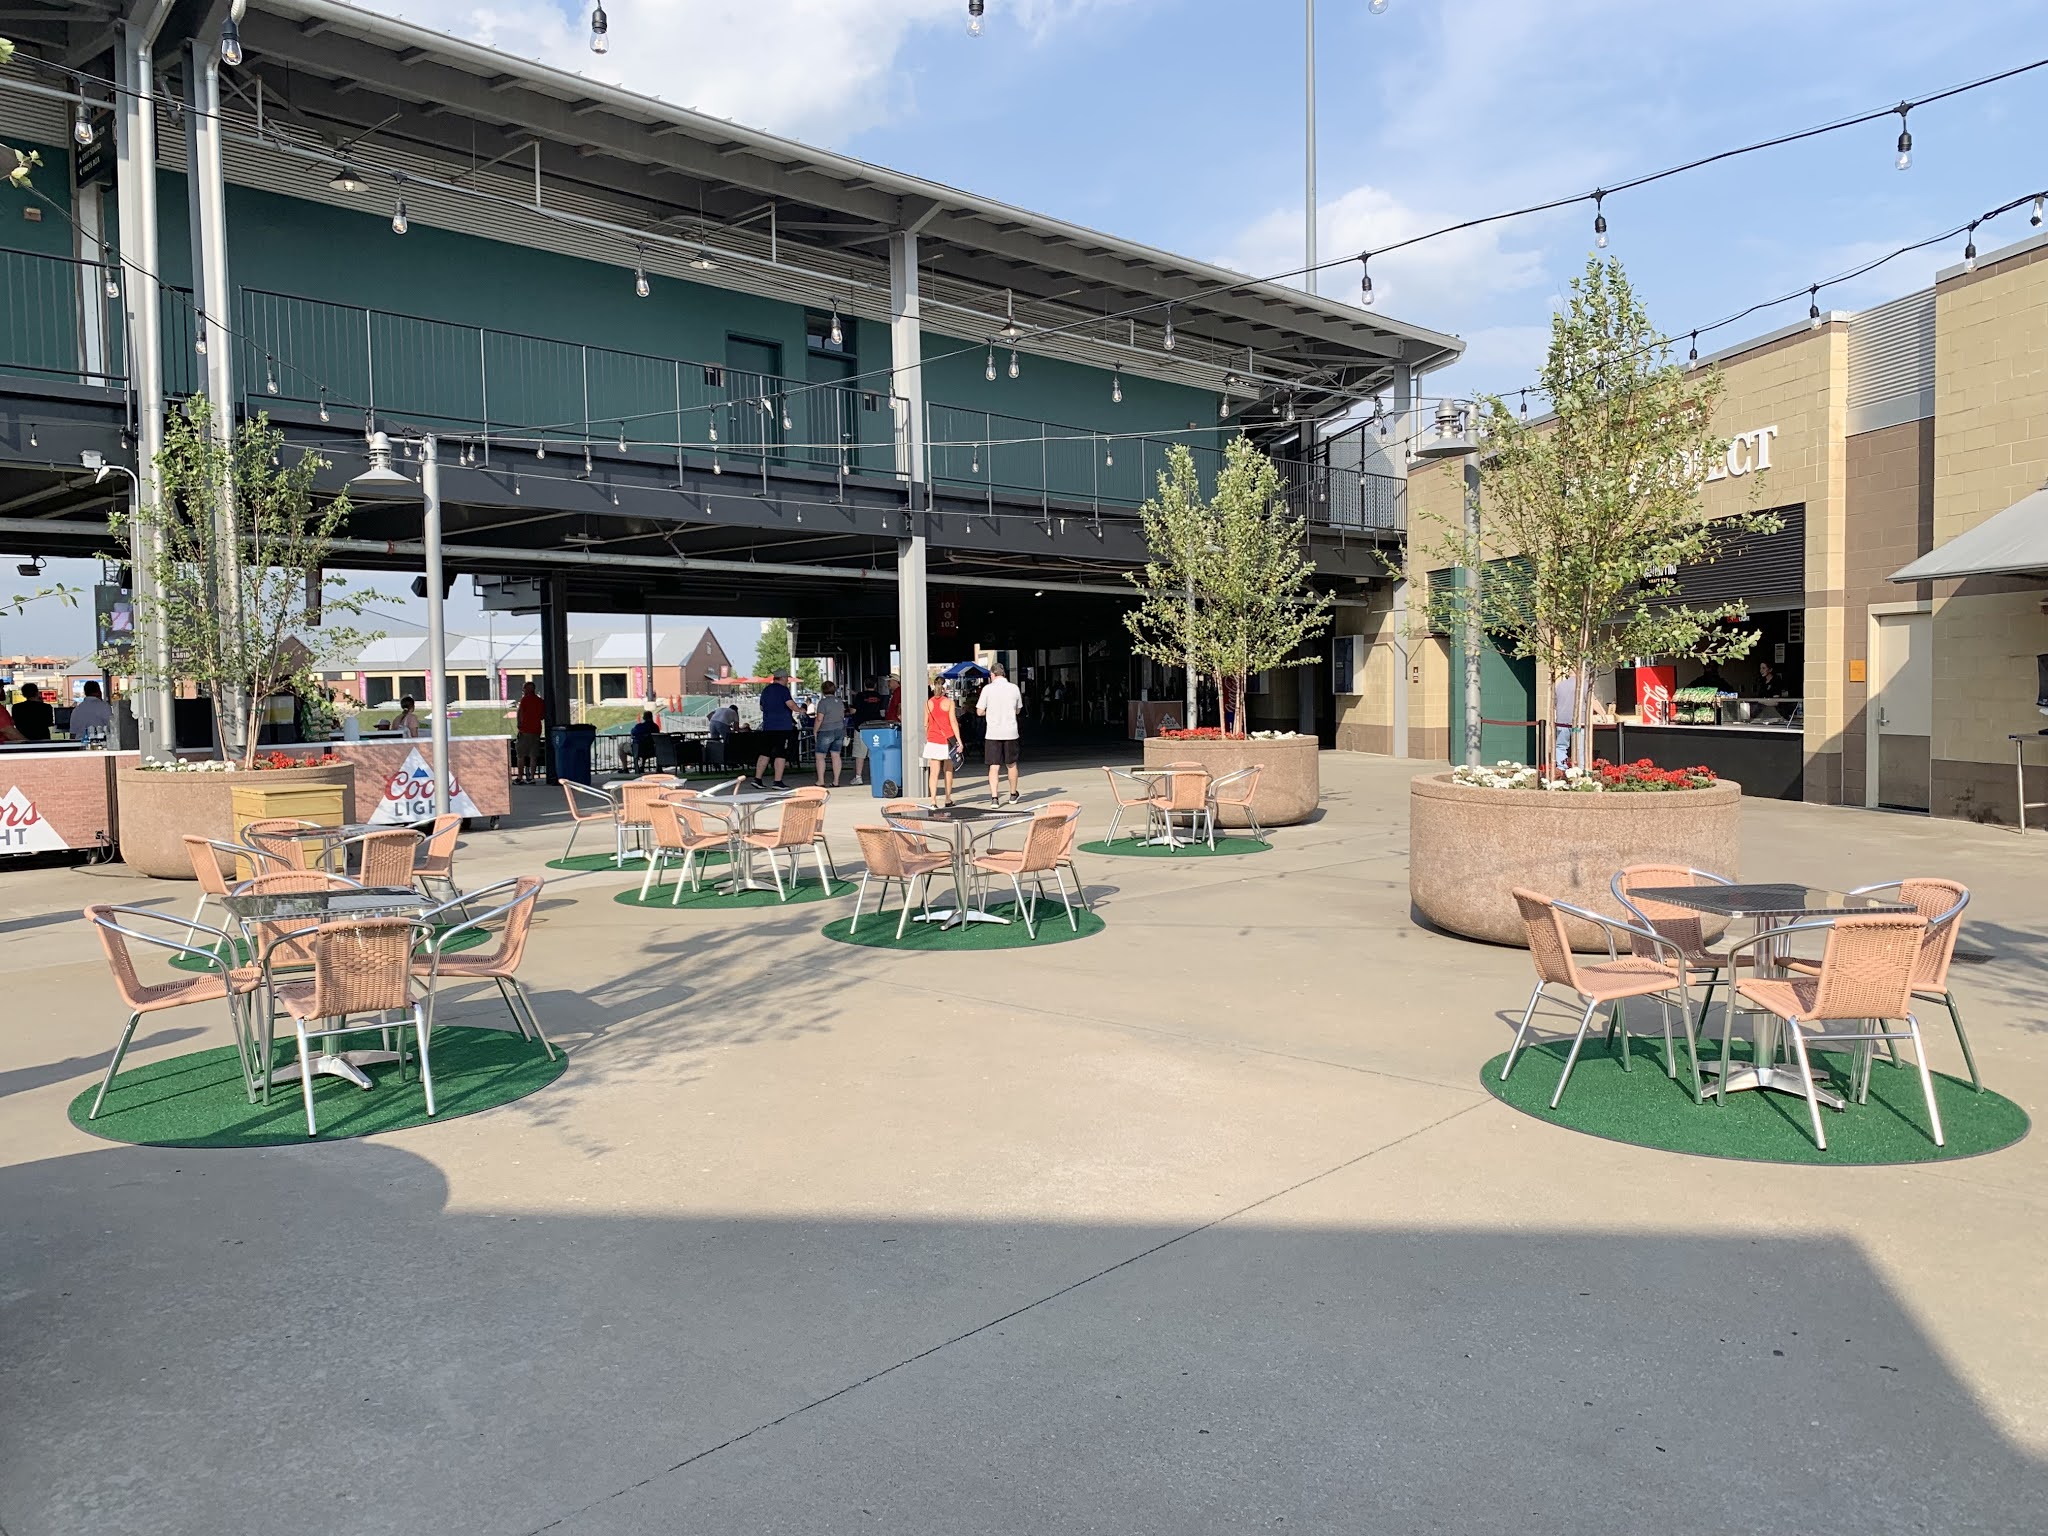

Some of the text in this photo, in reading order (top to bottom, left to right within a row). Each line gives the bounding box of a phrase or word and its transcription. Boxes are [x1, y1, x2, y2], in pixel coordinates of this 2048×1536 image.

[940, 601, 955, 609] 101
[940, 620, 956, 628] 103
[383, 771, 462, 800] Coos
[394, 798, 453, 817] LIGH
